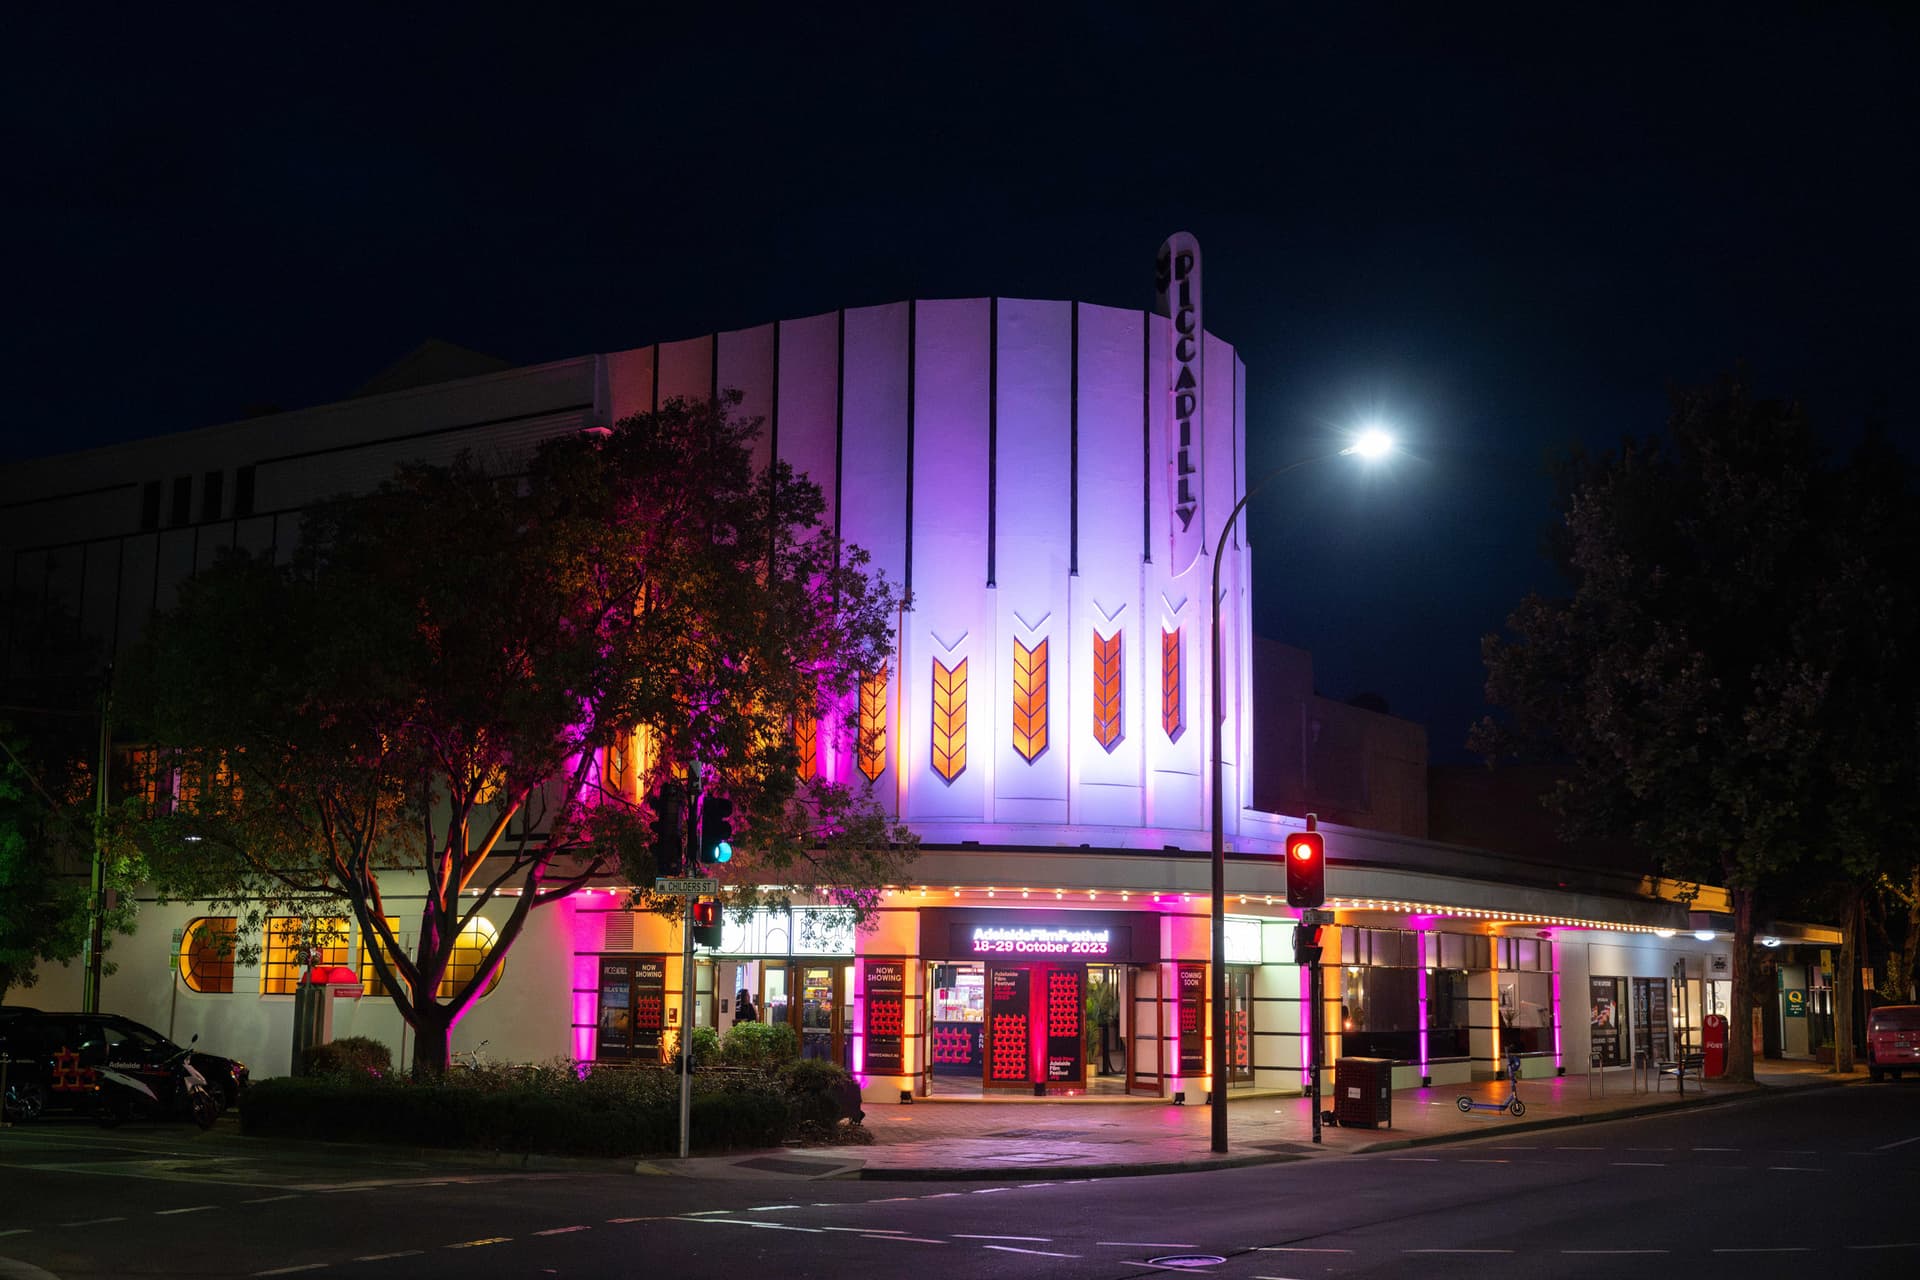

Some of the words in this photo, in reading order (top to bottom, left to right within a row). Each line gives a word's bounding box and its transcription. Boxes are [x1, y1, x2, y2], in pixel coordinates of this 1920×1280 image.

[1175, 253, 1197, 532] PICCADILLY
[669, 882, 700, 891] CHILDERS
[703, 882, 712, 891] ST
[1016, 942, 1069, 953] October
[1071, 942, 1108, 953] 2023
